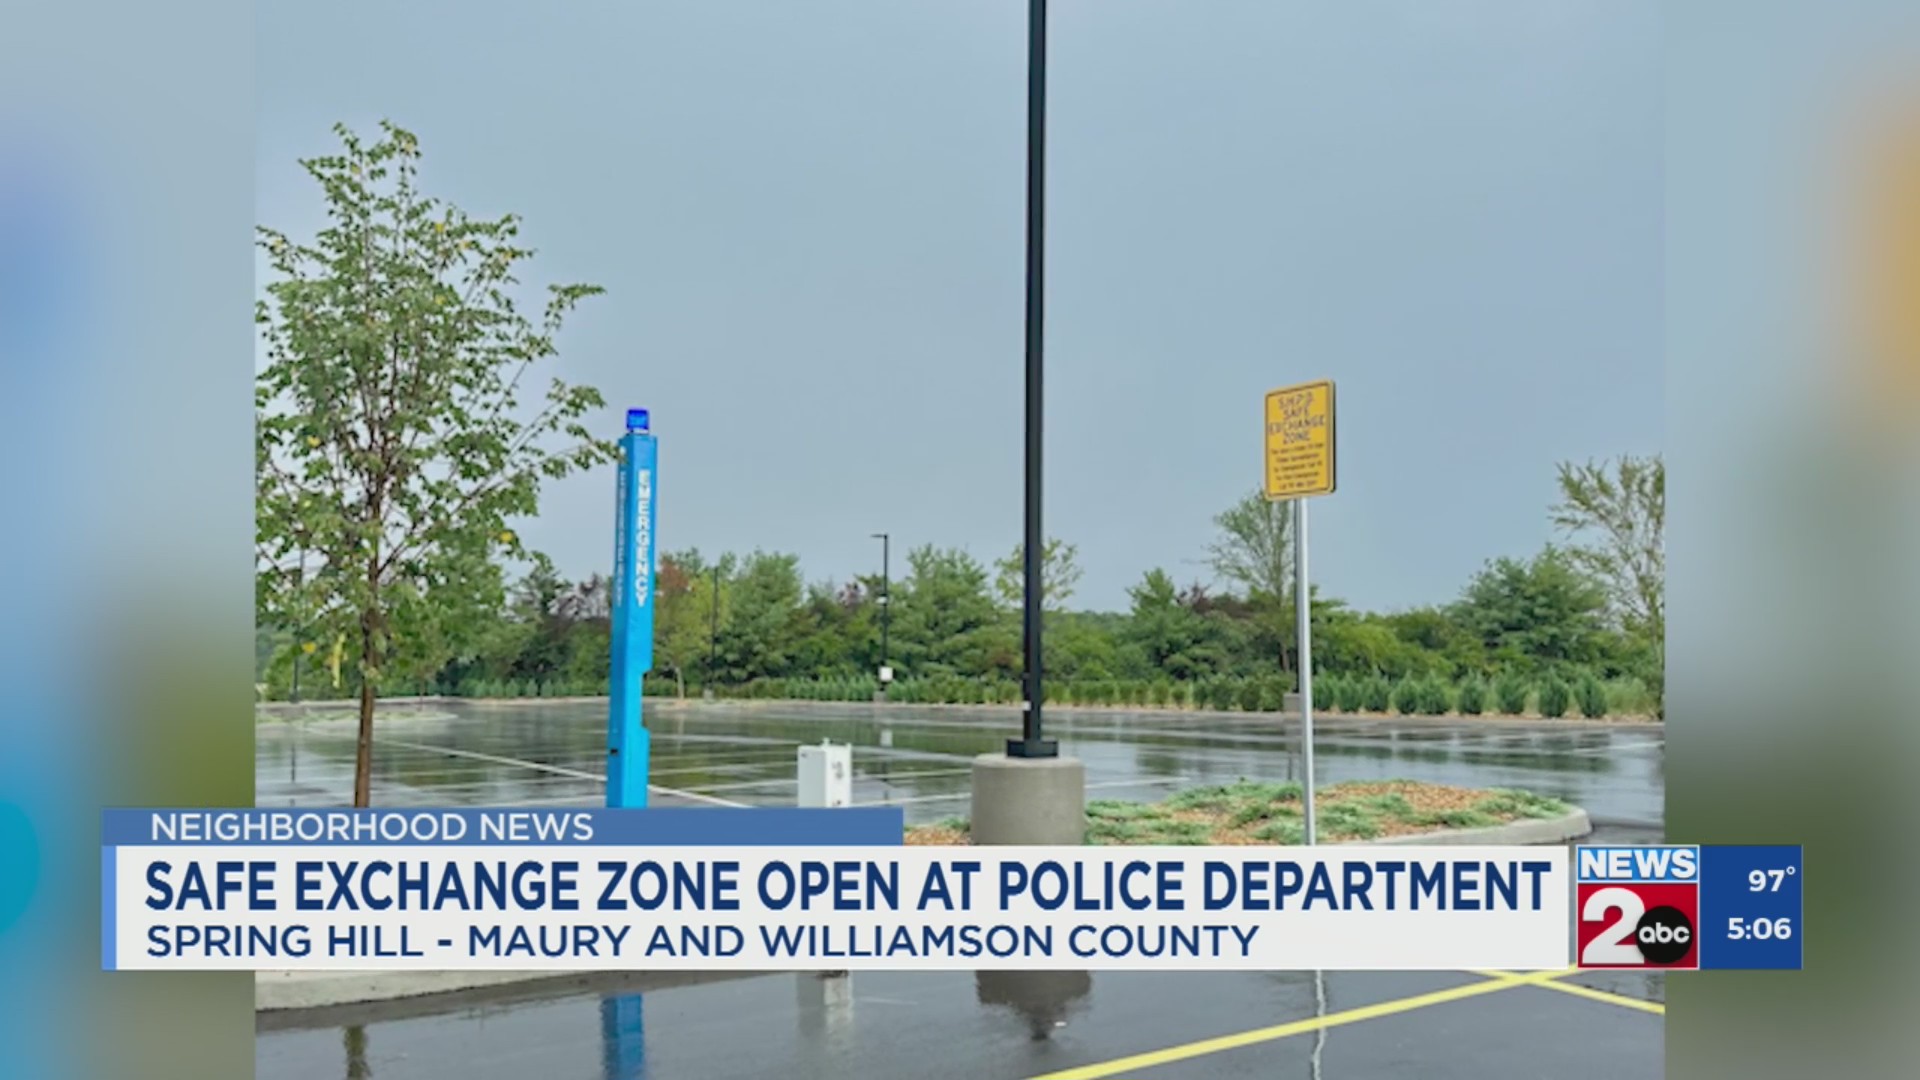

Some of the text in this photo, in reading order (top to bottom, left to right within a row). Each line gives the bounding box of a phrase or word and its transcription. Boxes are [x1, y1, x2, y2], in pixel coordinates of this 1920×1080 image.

[1283, 405, 1309, 421] SAFE
[1267, 414, 1325, 436] EXCHANGE
[1283, 429, 1310, 445] ZONE
[635, 469, 651, 608] EMERGENCY
